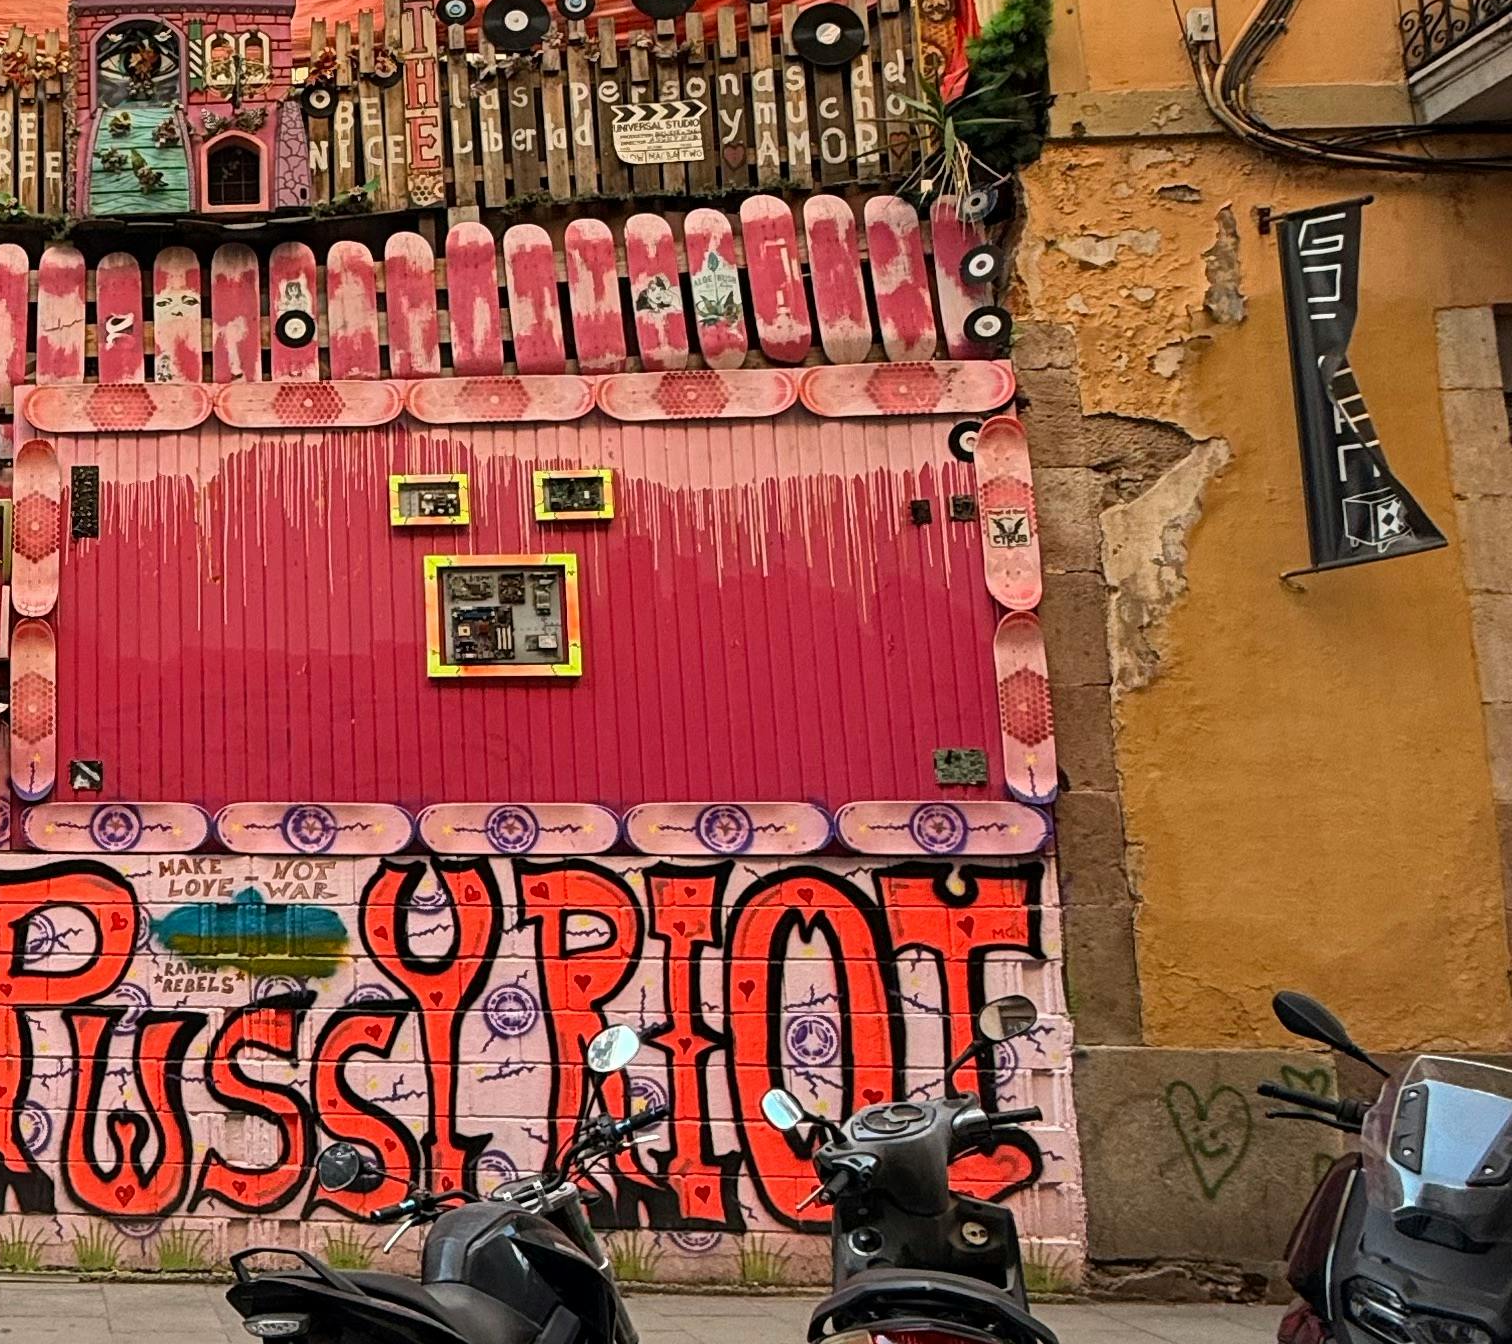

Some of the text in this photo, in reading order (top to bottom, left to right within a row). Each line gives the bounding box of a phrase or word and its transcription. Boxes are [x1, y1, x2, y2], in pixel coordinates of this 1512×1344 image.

[853, 50, 906, 88] del
[400, 0, 443, 170] THE
[334, 97, 382, 131] BE
[666, 119, 700, 129] STUDIO
[453, 110, 593, 154] Libertad
[309, 135, 405, 172] NICE
[756, 129, 880, 167] AMOR
[159, 858, 222, 878] MAKE
[272, 860, 337, 882] NOT
[168, 877, 234, 897] LOVE
[264, 881, 339, 900] WAR
[162, 976, 234, 994] REBELS
